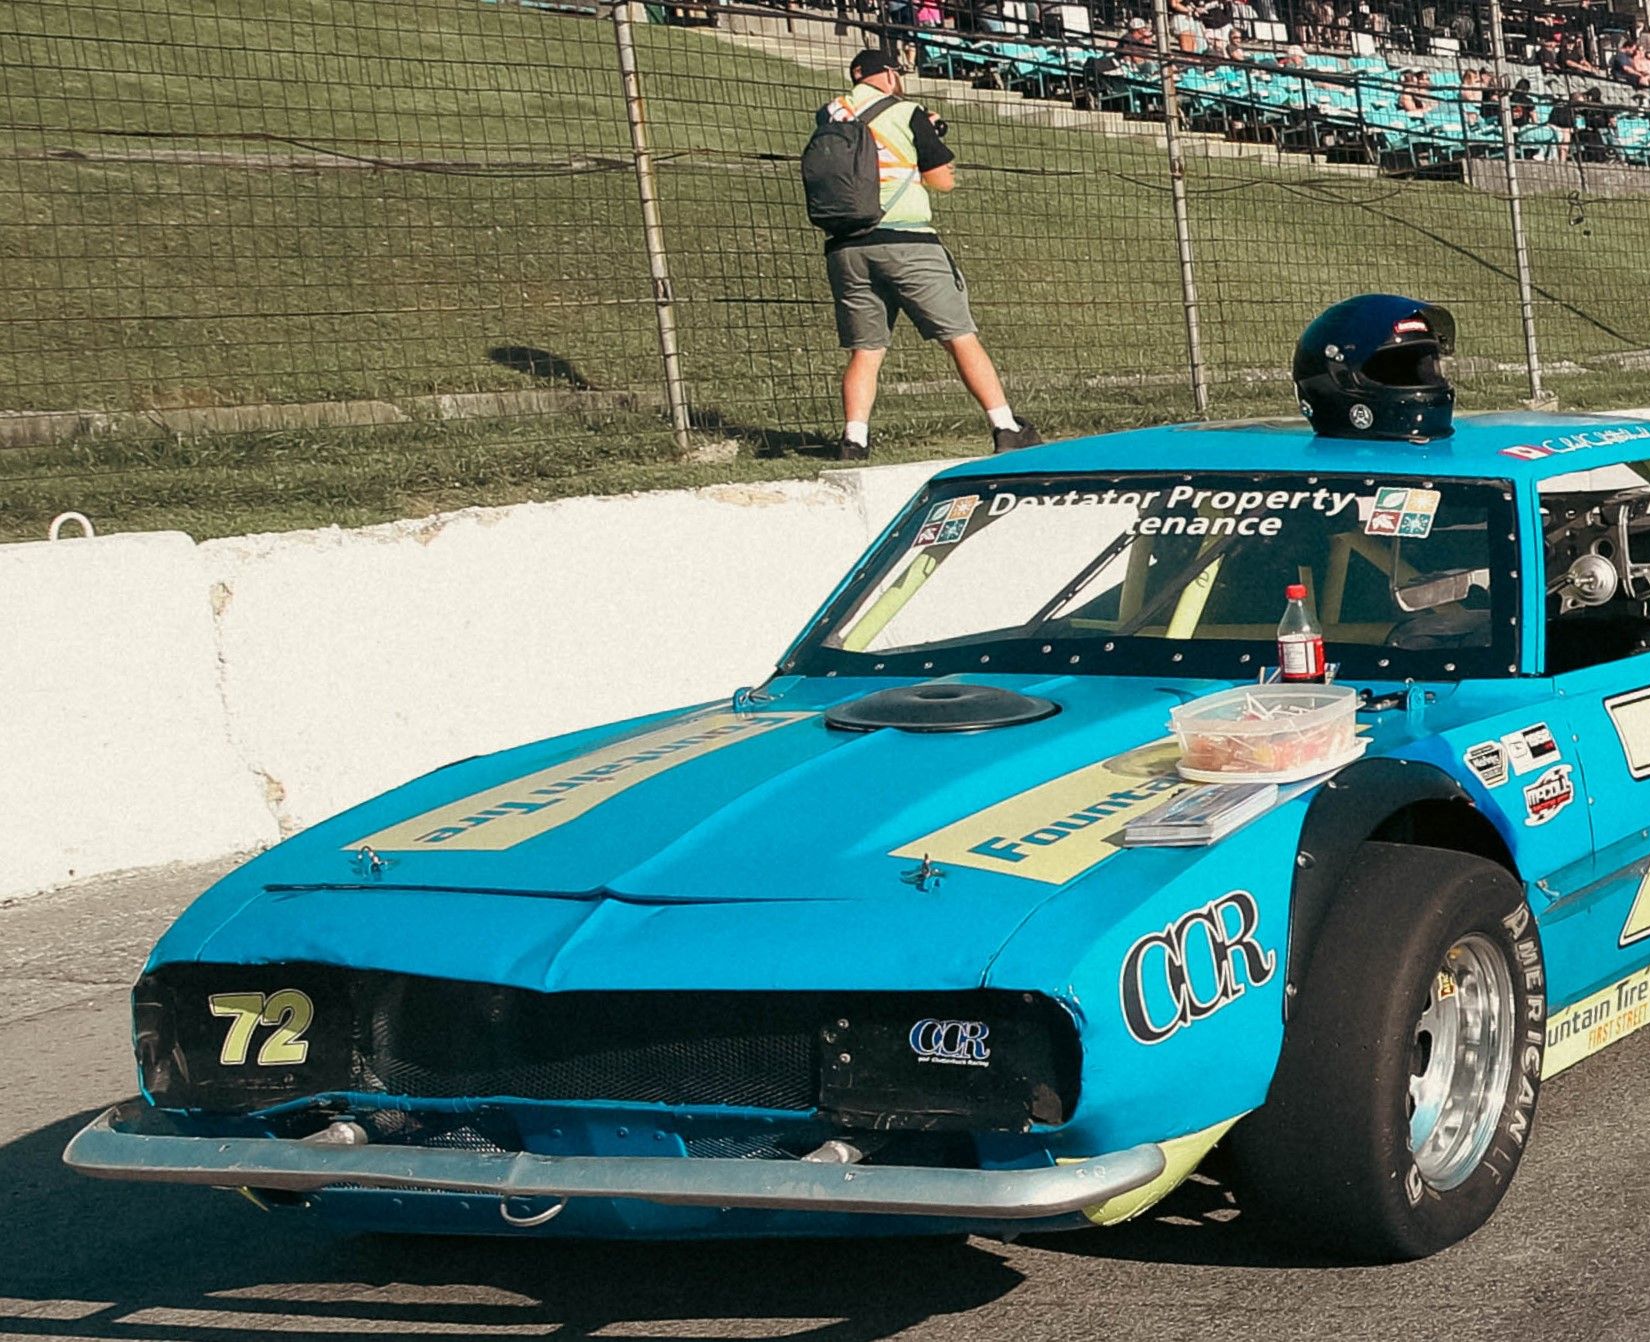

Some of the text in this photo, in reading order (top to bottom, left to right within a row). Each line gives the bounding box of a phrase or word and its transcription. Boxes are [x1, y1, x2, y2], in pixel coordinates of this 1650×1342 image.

[1125, 511, 1283, 537] tenance
[1166, 485, 1358, 517] Property
[413, 798, 566, 844] Tire
[967, 773, 1182, 863] Founta
[208, 988, 314, 1066] 72
[1501, 901, 1544, 1144] AMERICAN
[1547, 979, 1649, 1048] untain Tire
[1588, 1003, 1649, 1050] FIRST STREET
